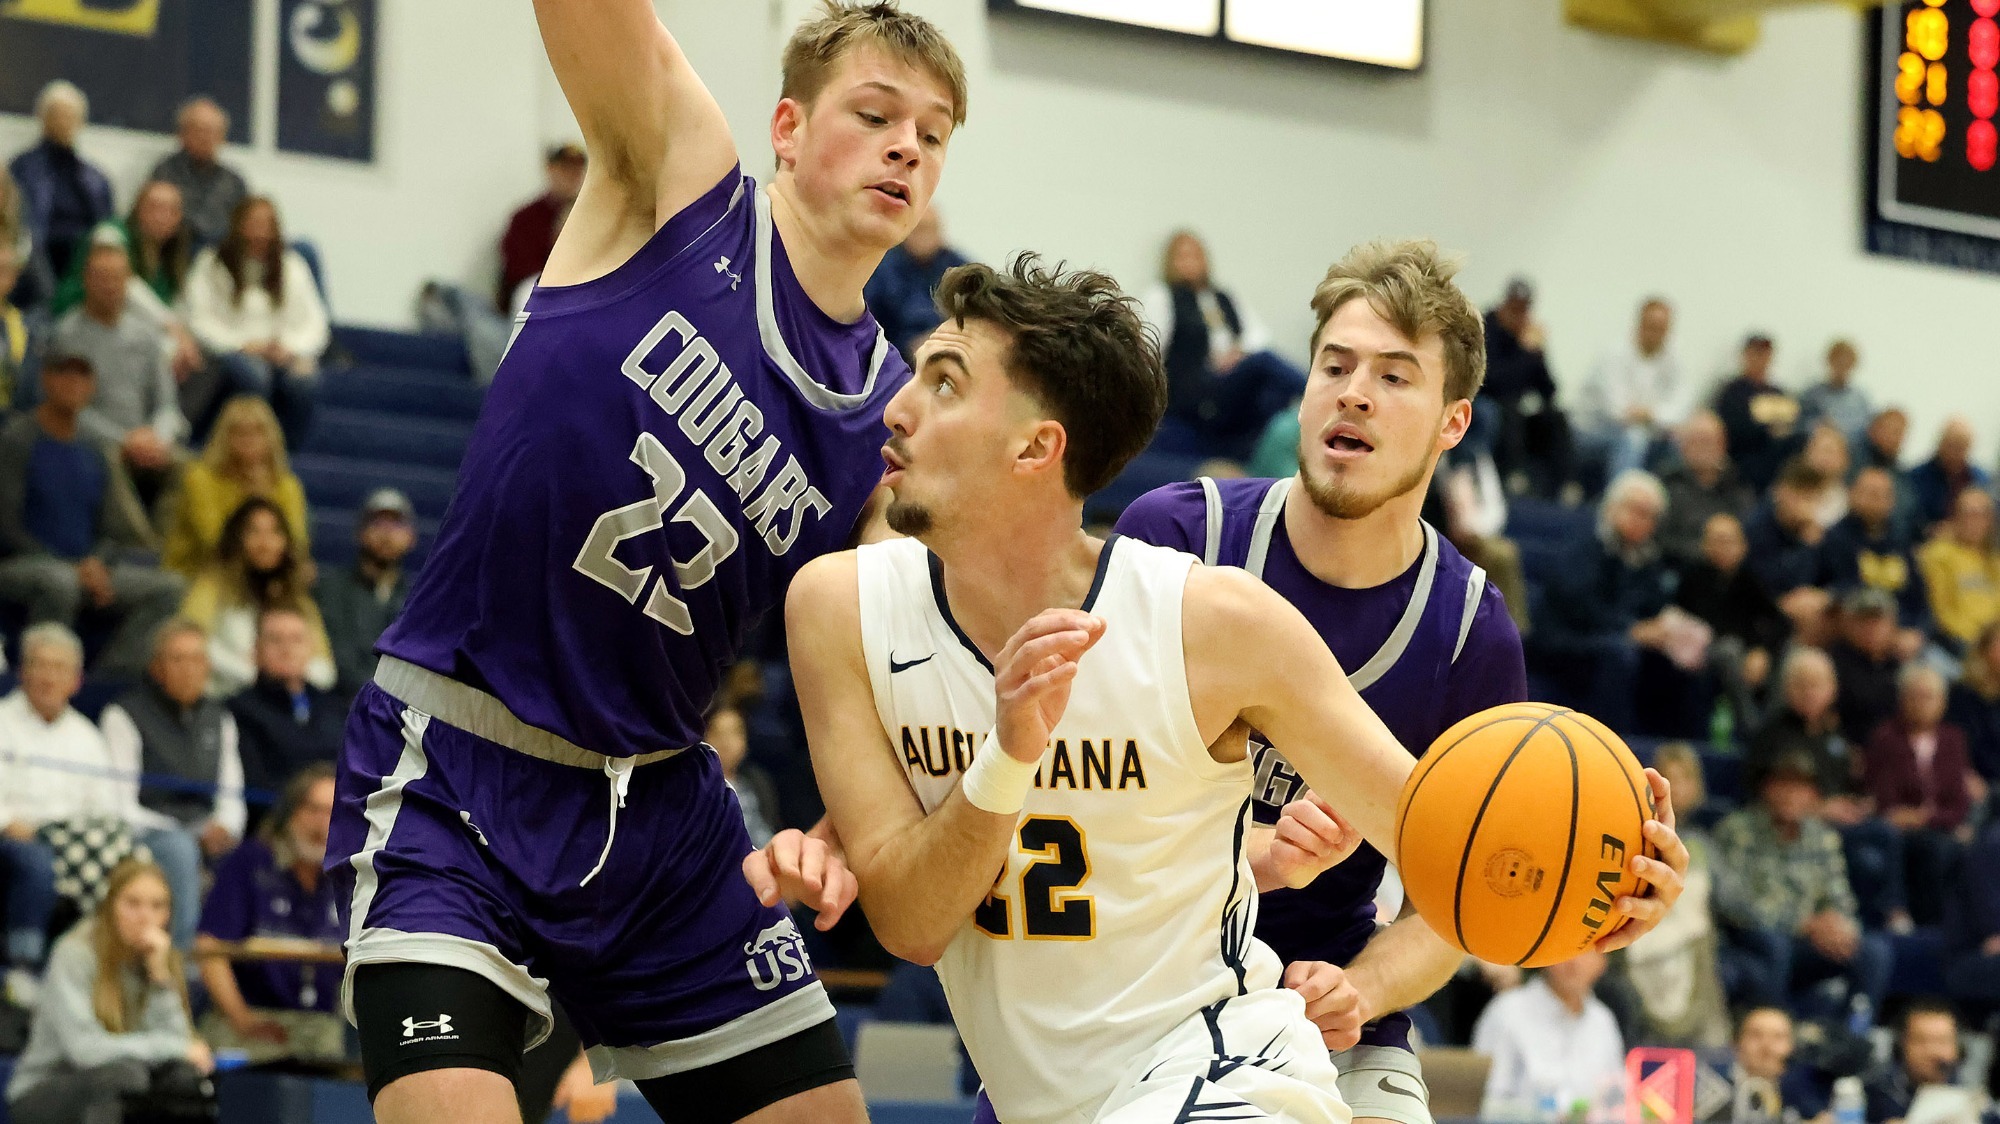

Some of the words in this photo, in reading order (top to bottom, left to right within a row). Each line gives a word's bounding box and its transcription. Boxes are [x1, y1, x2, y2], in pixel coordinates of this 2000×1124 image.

[621, 310, 833, 556] COUGARS
[1582, 833, 1625, 930] EVO
[399, 1037, 424, 1046] UNDER
